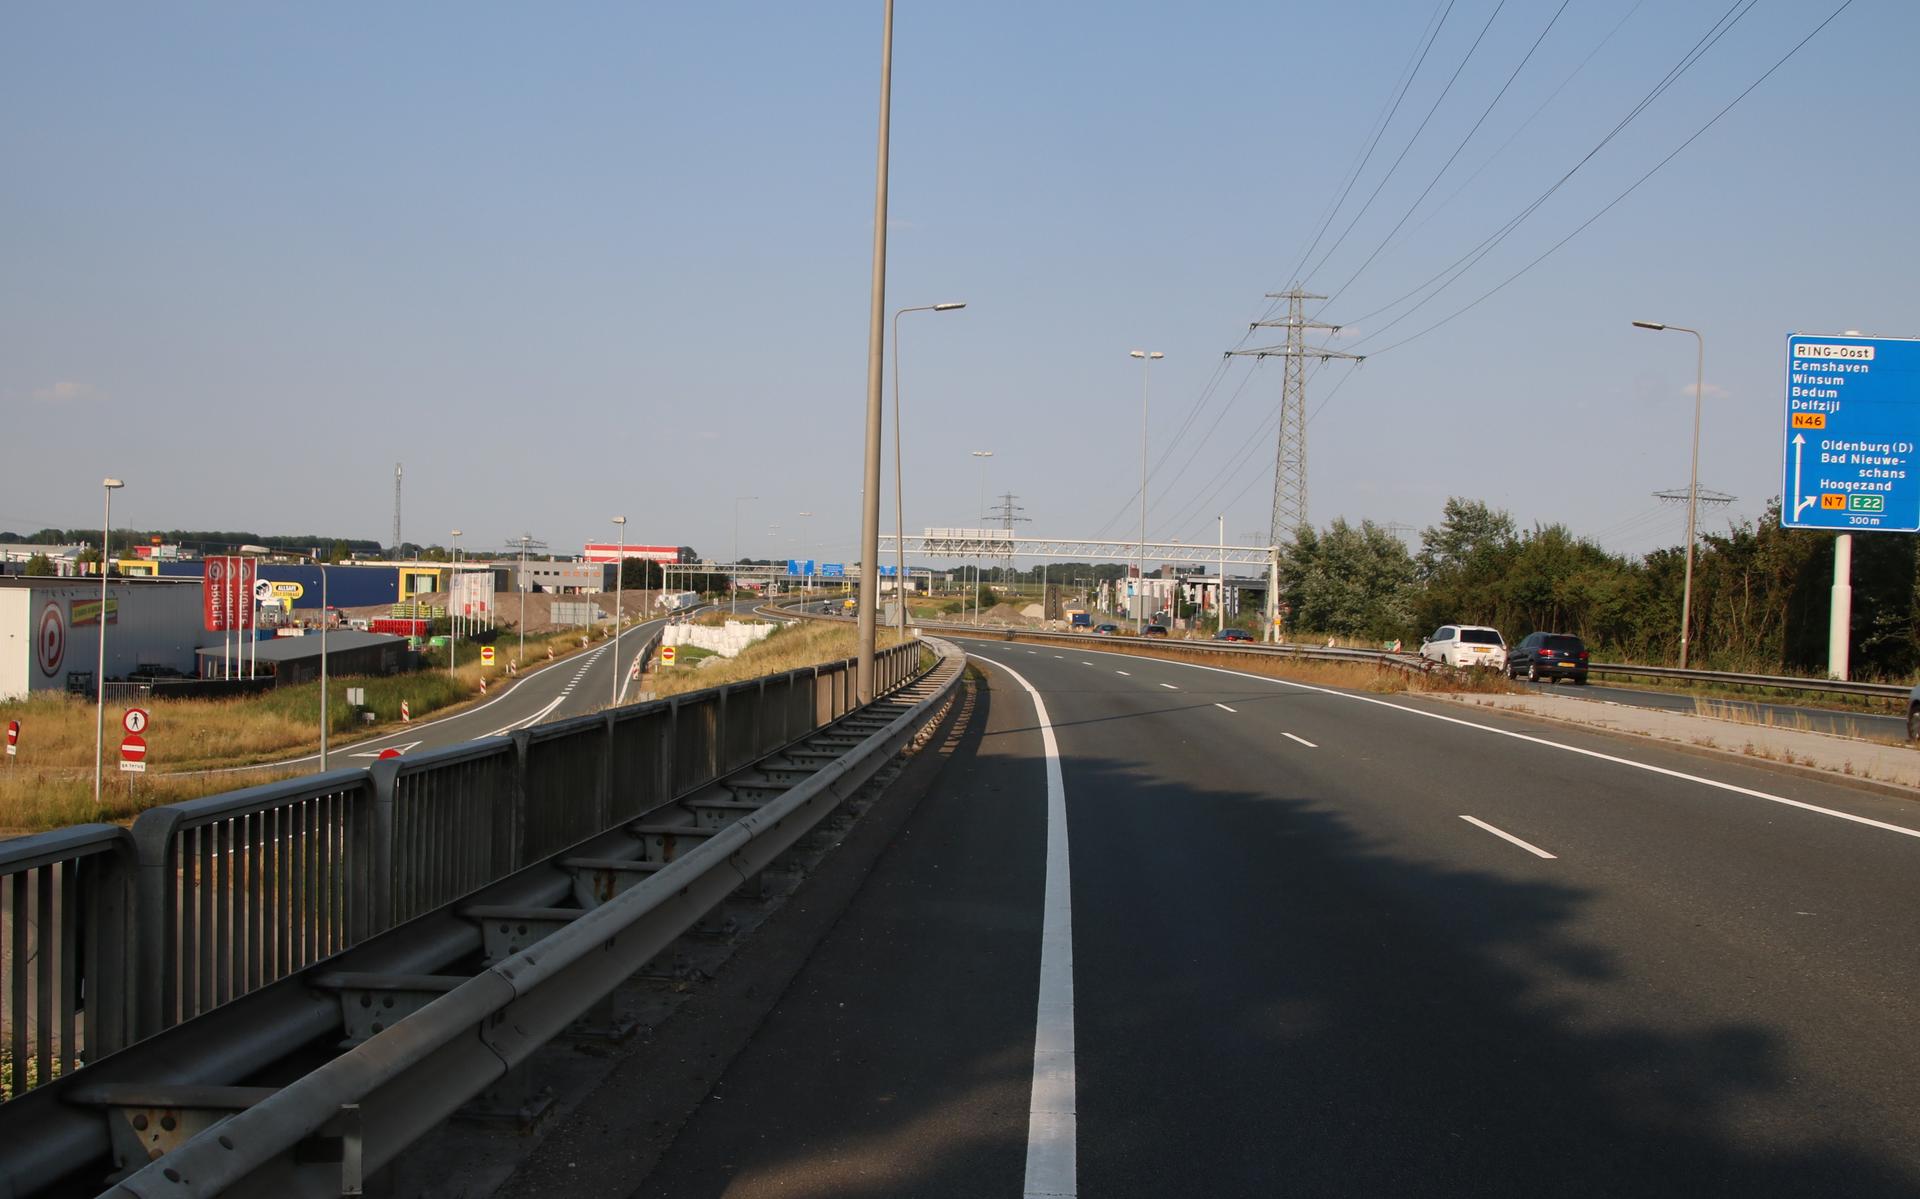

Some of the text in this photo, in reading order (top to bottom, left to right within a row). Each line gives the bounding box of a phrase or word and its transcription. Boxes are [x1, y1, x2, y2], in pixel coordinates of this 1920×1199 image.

[1797, 345, 1869, 358] RING-Oost
[1793, 360, 1869, 373] Eemshaven
[1792, 374, 1844, 385] Winsum
[1792, 386, 1838, 398] Bedum
[1791, 399, 1840, 414] Delfzijl
[1795, 415, 1822, 426] N46
[1821, 440, 1913, 455] Oldenburg (D)
[1821, 453, 1906, 465] Bad Nieuwe-
[1859, 467, 1906, 479] schans
[1820, 479, 1892, 492] Hoogezand
[1853, 498, 1881, 509] E22
[1849, 516, 1869, 525] 300
